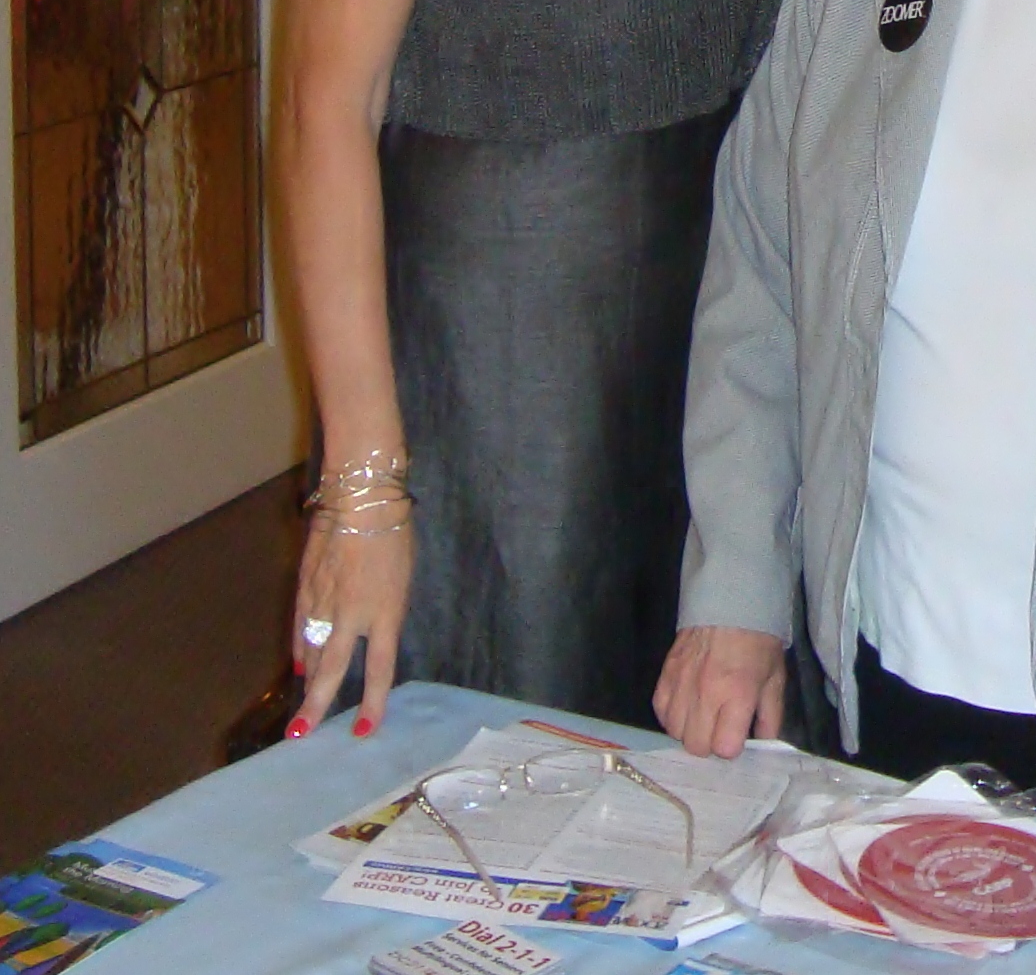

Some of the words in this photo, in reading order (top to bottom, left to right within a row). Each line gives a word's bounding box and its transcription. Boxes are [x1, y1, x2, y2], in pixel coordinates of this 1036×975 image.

[881, 0, 926, 25] ZOOMER
[354, 881, 442, 902] Reasons
[445, 893, 504, 910] Great
[507, 902, 540, 914] 30
[458, 920, 505, 945] Dial
[494, 940, 551, 968] 2-1-1
